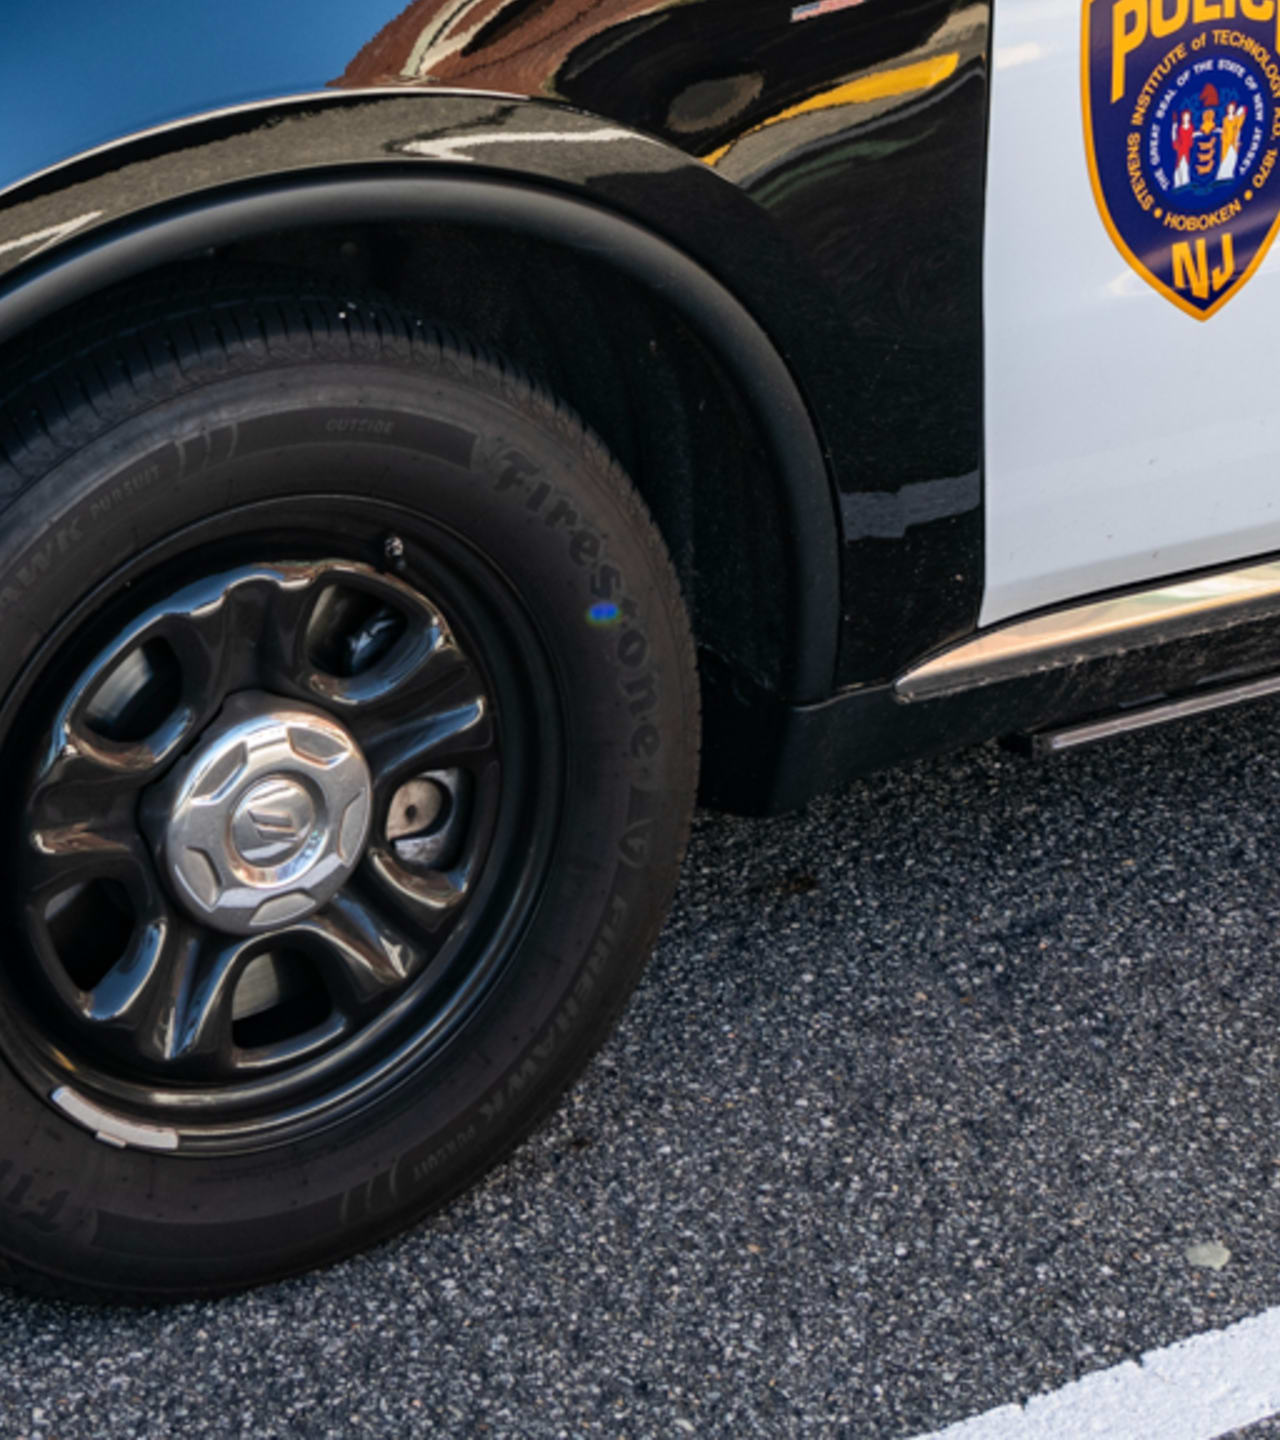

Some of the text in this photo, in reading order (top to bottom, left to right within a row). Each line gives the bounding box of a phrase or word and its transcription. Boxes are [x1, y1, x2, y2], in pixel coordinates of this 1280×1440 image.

[1191, 32, 1206, 50] of
[1131, 42, 1188, 125] INSTITUTE
[1155, 89, 1178, 119] SEAL
[1176, 70, 1191, 87] OF
[1193, 59, 1214, 75] THE
[1217, 58, 1246, 78] STATE
[1127, 132, 1155, 211] STEVENS
[1252, 148, 1278, 189] 1870
[1163, 199, 1242, 231] HOBOKEN
[1171, 232, 1236, 300] NJ
